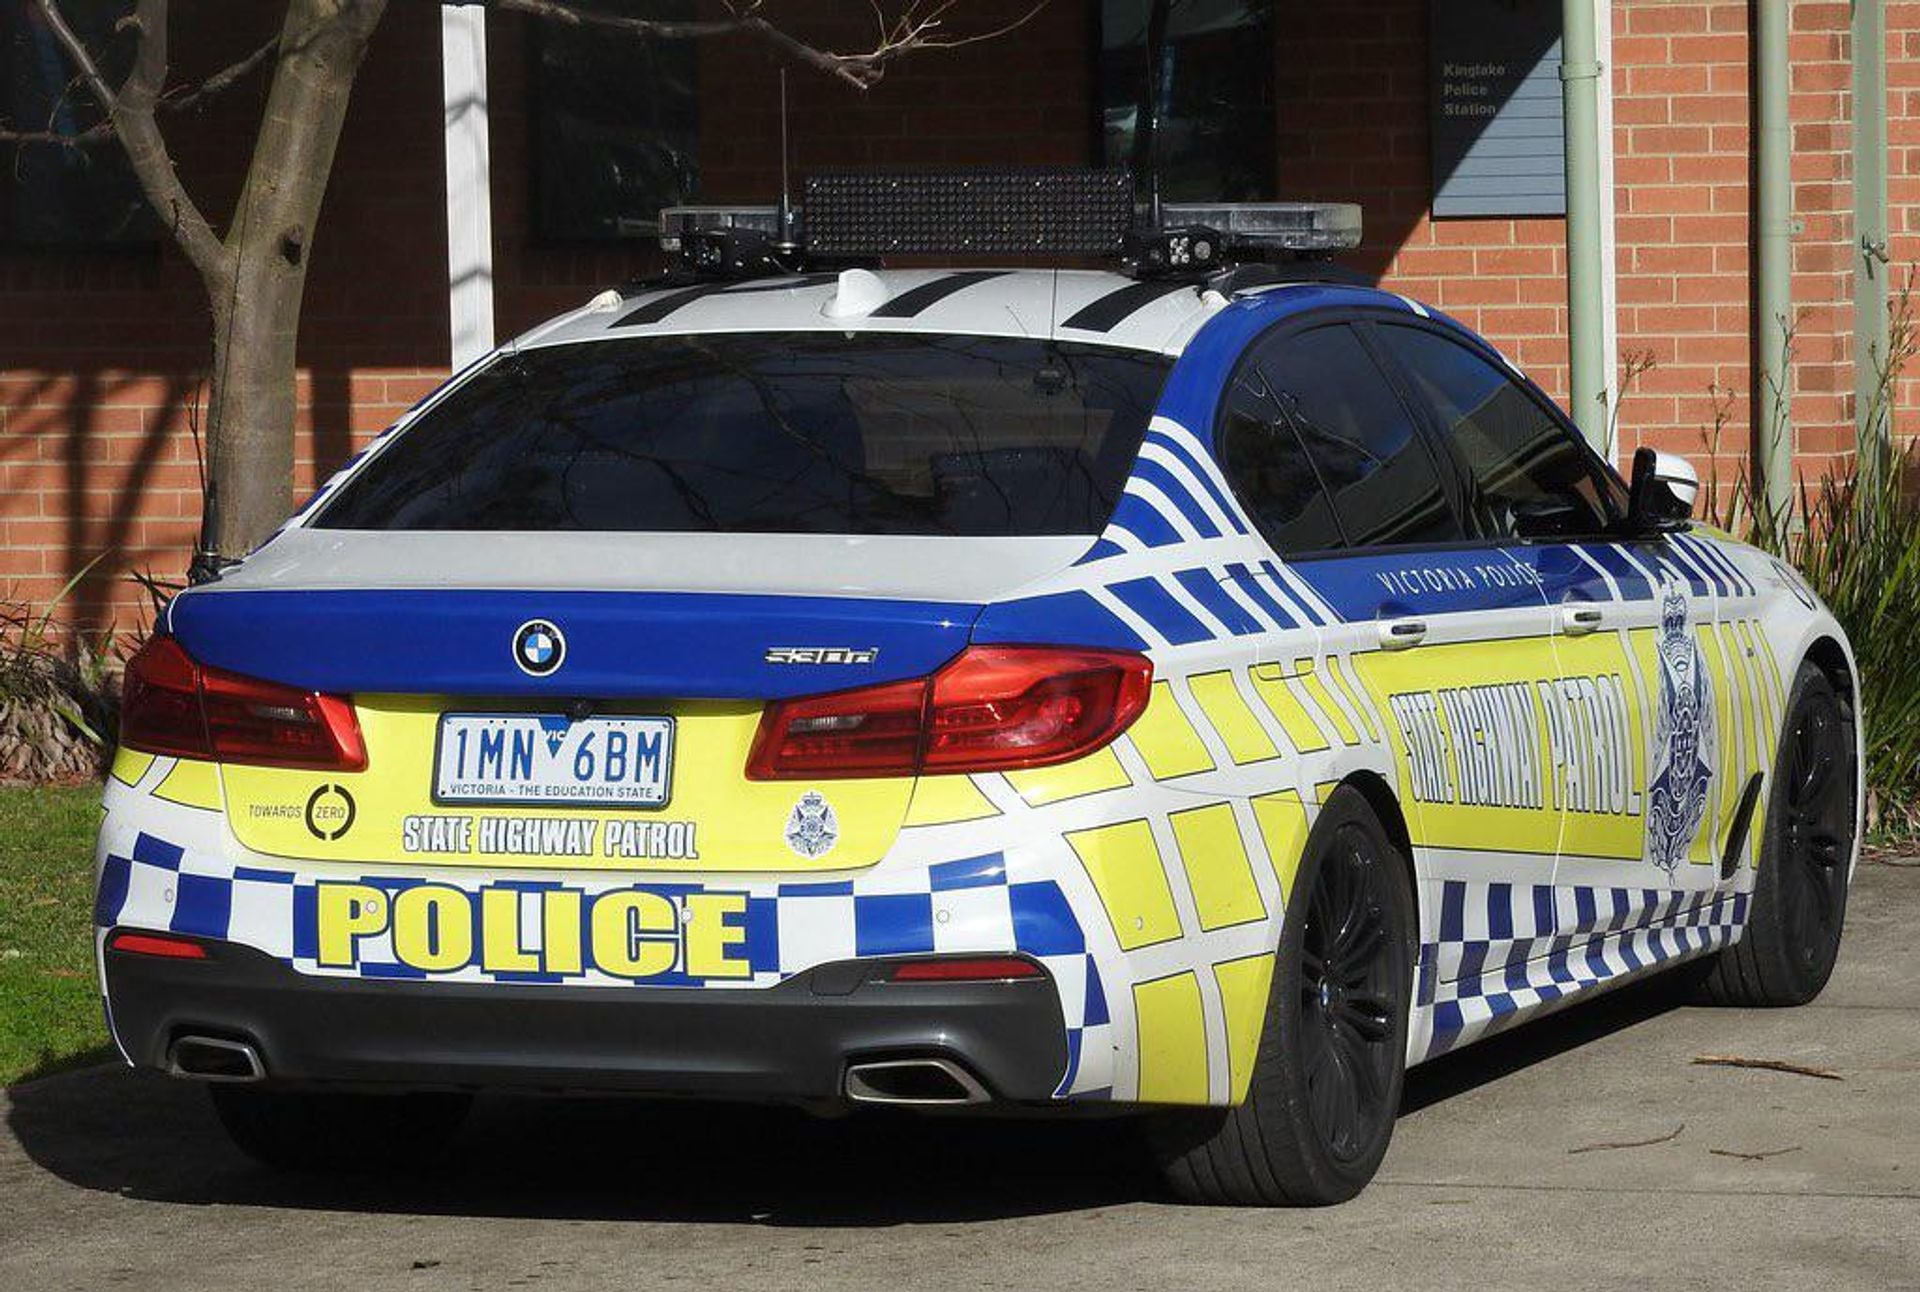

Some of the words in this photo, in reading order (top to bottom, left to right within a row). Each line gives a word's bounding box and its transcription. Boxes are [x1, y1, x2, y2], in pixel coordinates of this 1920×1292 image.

[1443, 62, 1505, 77] Kinglake
[1443, 83, 1488, 96] Police
[1443, 103, 1496, 116] Station
[1376, 568, 1476, 595] VICTORIA
[1474, 562, 1544, 588] POLICE
[543, 730, 566, 741] VIC
[1389, 690, 1454, 804] STATE
[1437, 681, 1543, 810] HIGHWAY
[1536, 673, 1642, 816] PATROL
[457, 728, 535, 780] 1MN
[574, 731, 662, 783] 6BM
[450, 784, 507, 795] VICTORIA
[519, 785, 540, 796] THE
[545, 785, 613, 797] EDUCATION
[617, 787, 652, 798] STATE
[249, 804, 301, 818] TOWARDS
[315, 806, 345, 819] ZERO
[403, 815, 473, 853] STATE
[479, 817, 599, 857] HIGHWAY
[604, 819, 700, 860] PATROL
[316, 879, 755, 980] POLICE
